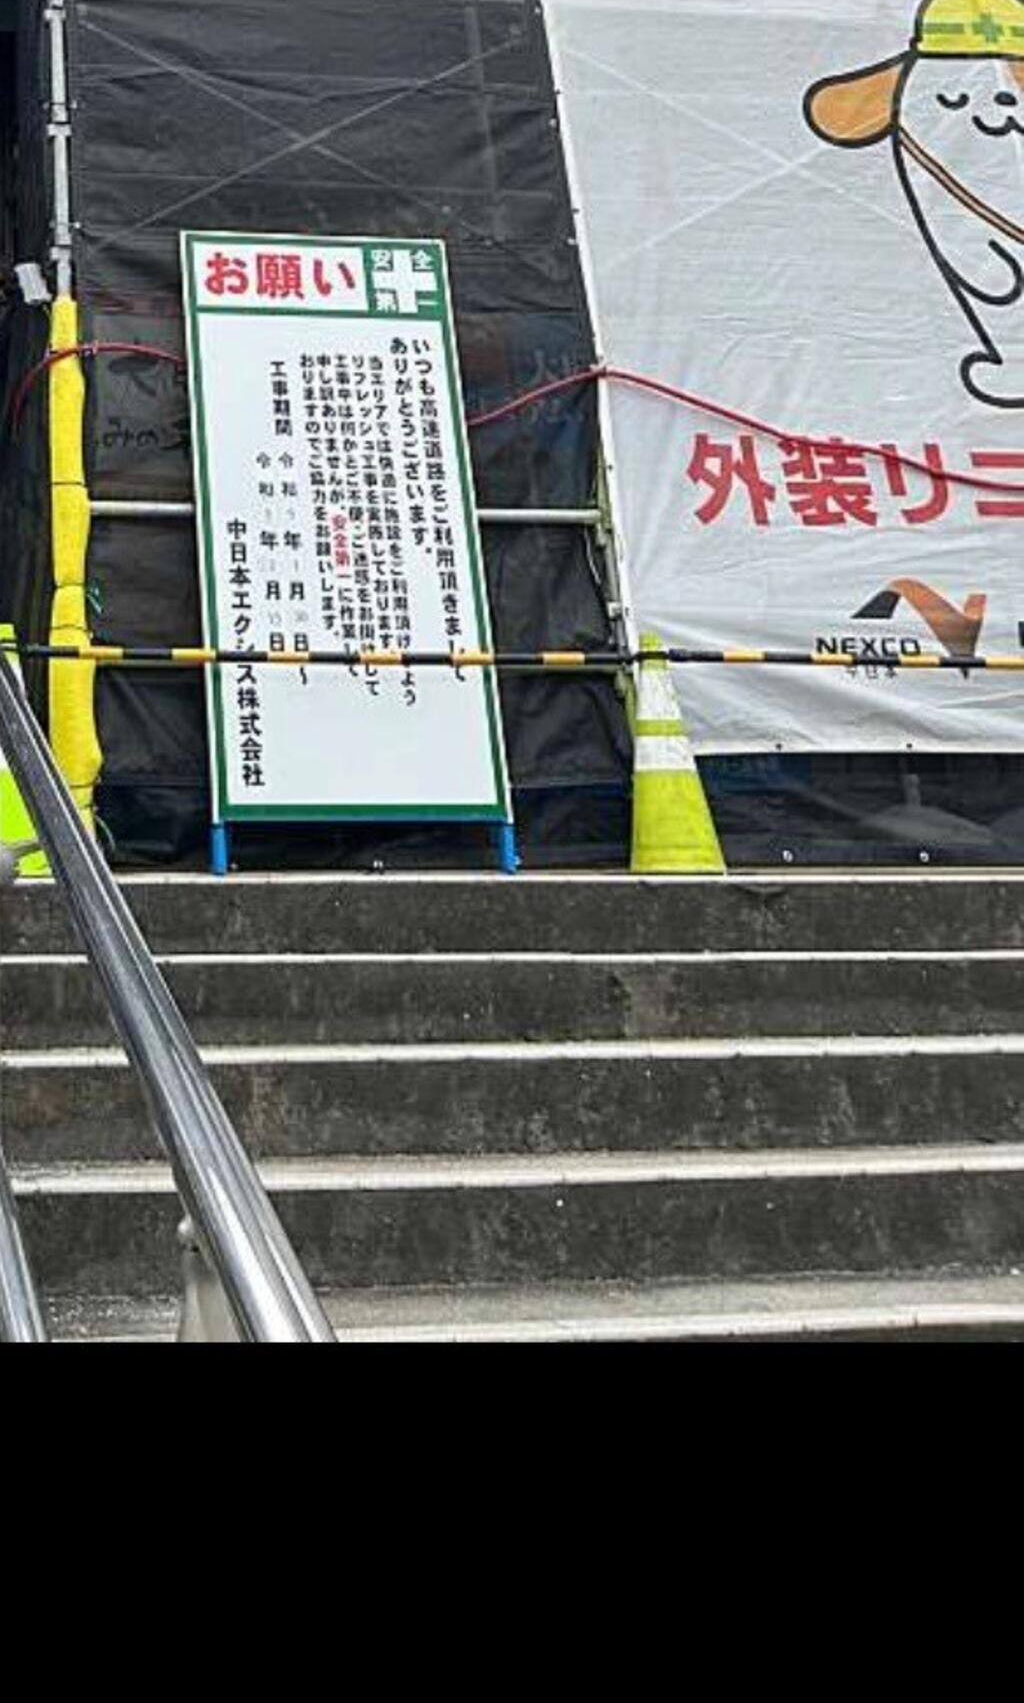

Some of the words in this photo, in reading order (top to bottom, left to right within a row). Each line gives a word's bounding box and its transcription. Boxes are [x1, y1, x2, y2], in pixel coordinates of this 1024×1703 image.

[205, 253, 356, 299] お願い
[270, 361, 293, 437] 工事期間
[390, 337, 432, 554] ありがとうございます。
[369, 355, 416, 706] 当エリアでは快適に施設をご利用頂けよう
[815, 636, 921, 657] NEXCO
